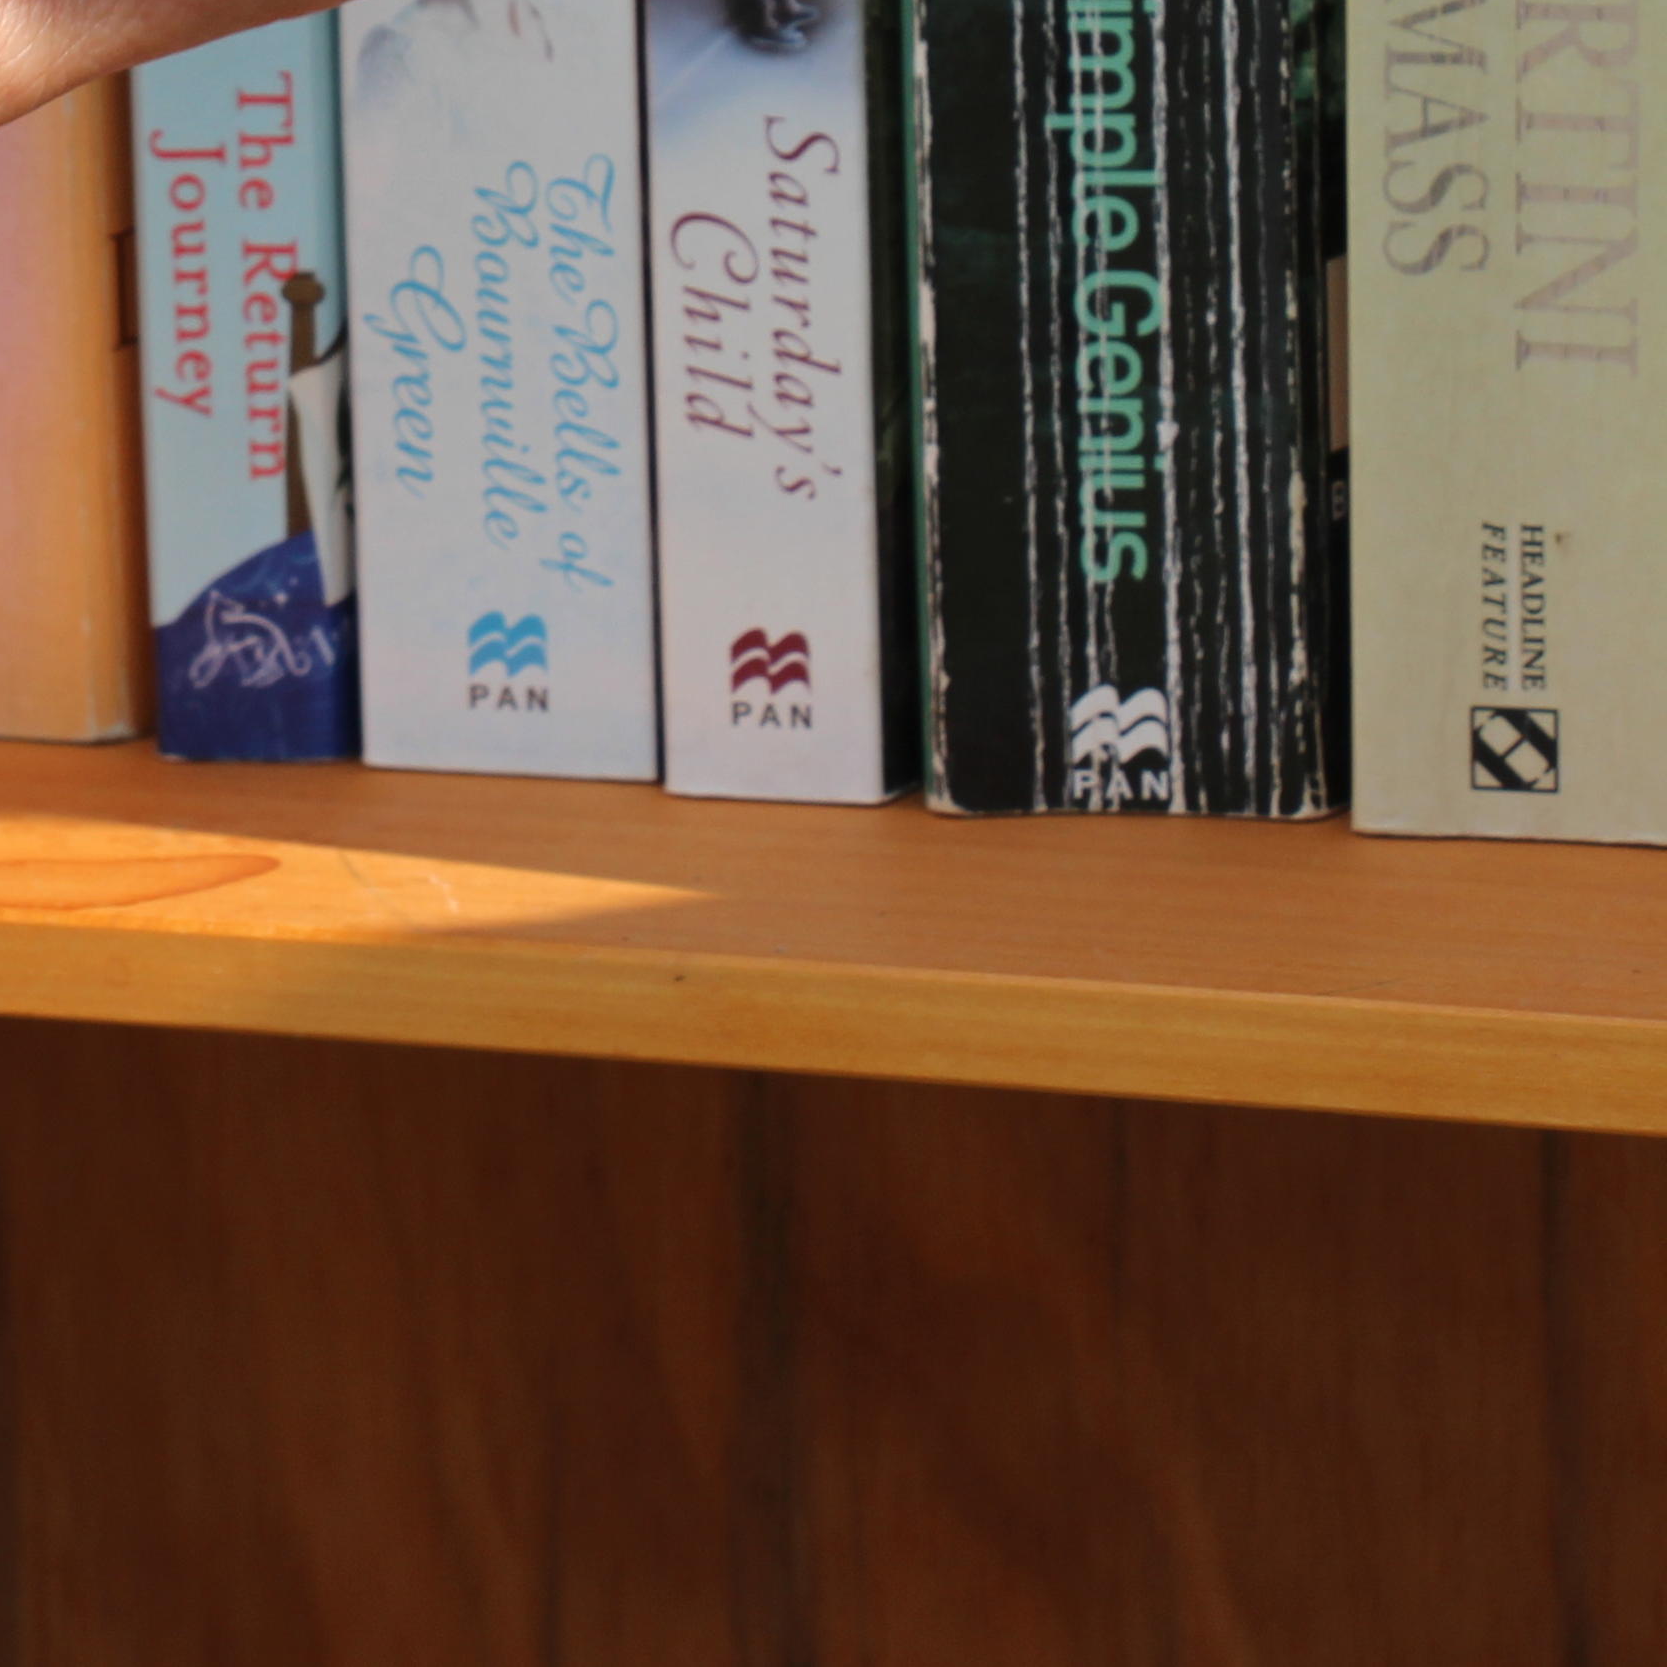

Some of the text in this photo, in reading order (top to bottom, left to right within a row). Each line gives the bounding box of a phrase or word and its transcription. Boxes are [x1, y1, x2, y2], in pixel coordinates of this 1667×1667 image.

[150, 129, 227, 417] Journey
[237, 71, 299, 482] The Return
[362, 244, 468, 499] Green
[466, 160, 549, 546] Bournville
[539, 152, 622, 593] The Bells of
[669, 210, 759, 441] Child
[746, 113, 843, 502] Saturday's
[1073, 269, 1167, 585] Genius
[468, 684, 550, 713] PAN
[730, 702, 814, 730] PAN
[1481, 521, 1508, 691] FEATURE
[1520, 523, 1547, 691] HEADLINE
[1071, 766, 1168, 802] PAN
